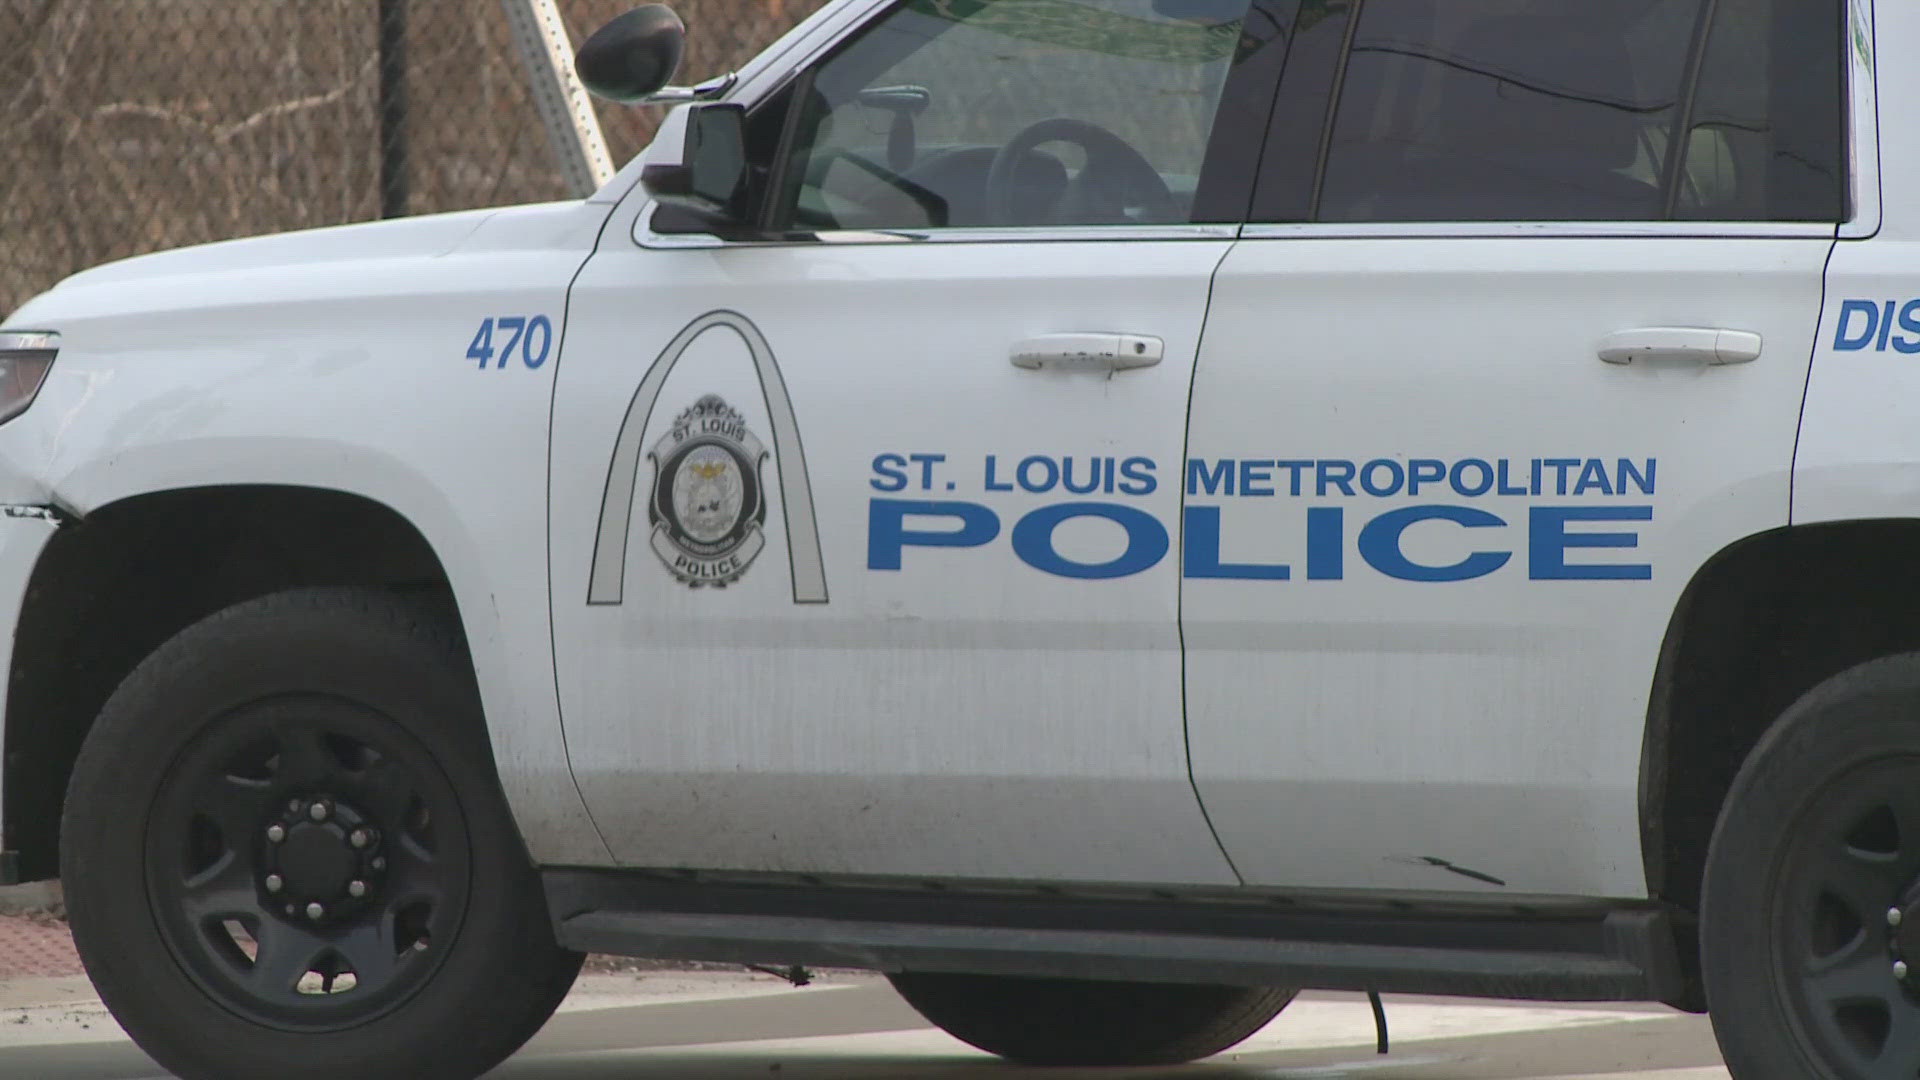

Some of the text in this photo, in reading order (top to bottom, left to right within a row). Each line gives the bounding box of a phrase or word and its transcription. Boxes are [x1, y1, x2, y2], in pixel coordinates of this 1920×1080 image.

[466, 316, 552, 369] 470
[701, 418, 746, 442] LOUIS
[870, 454, 1657, 498] ST. LOUIS METROPOLITAN
[867, 498, 1653, 583] POLICE
[674, 553, 742, 578] POLICE
